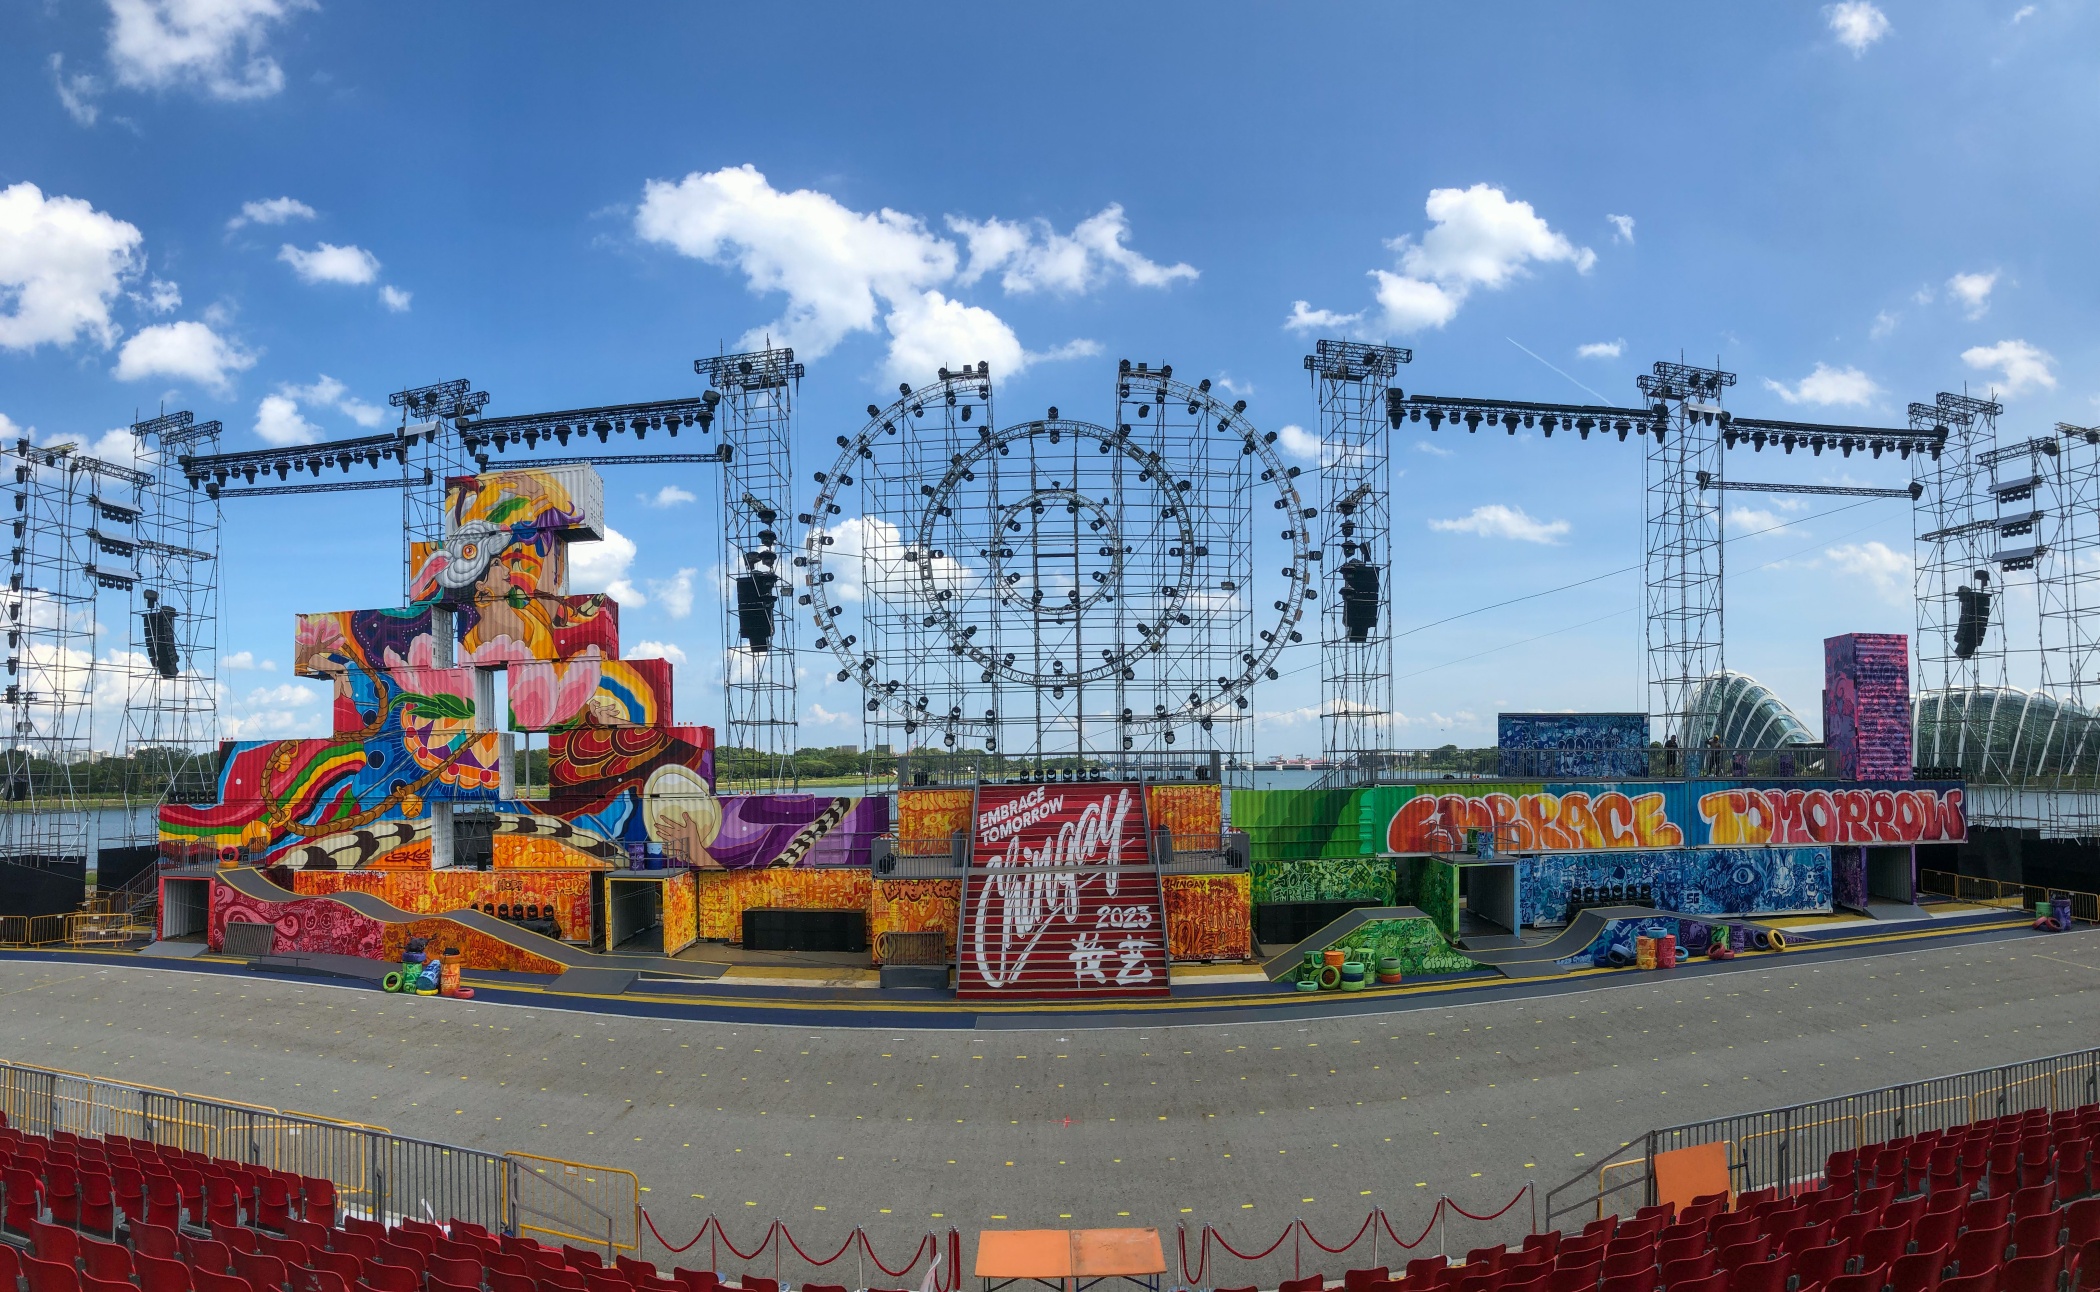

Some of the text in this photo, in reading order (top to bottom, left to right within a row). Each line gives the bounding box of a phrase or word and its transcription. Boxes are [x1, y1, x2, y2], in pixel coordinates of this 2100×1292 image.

[979, 786, 1046, 830] EMBRACE
[980, 794, 1064, 846] TOMORROW
[1387, 787, 1966, 852] EMBRACE TOMORROW
[1095, 905, 1153, 929] 2023
